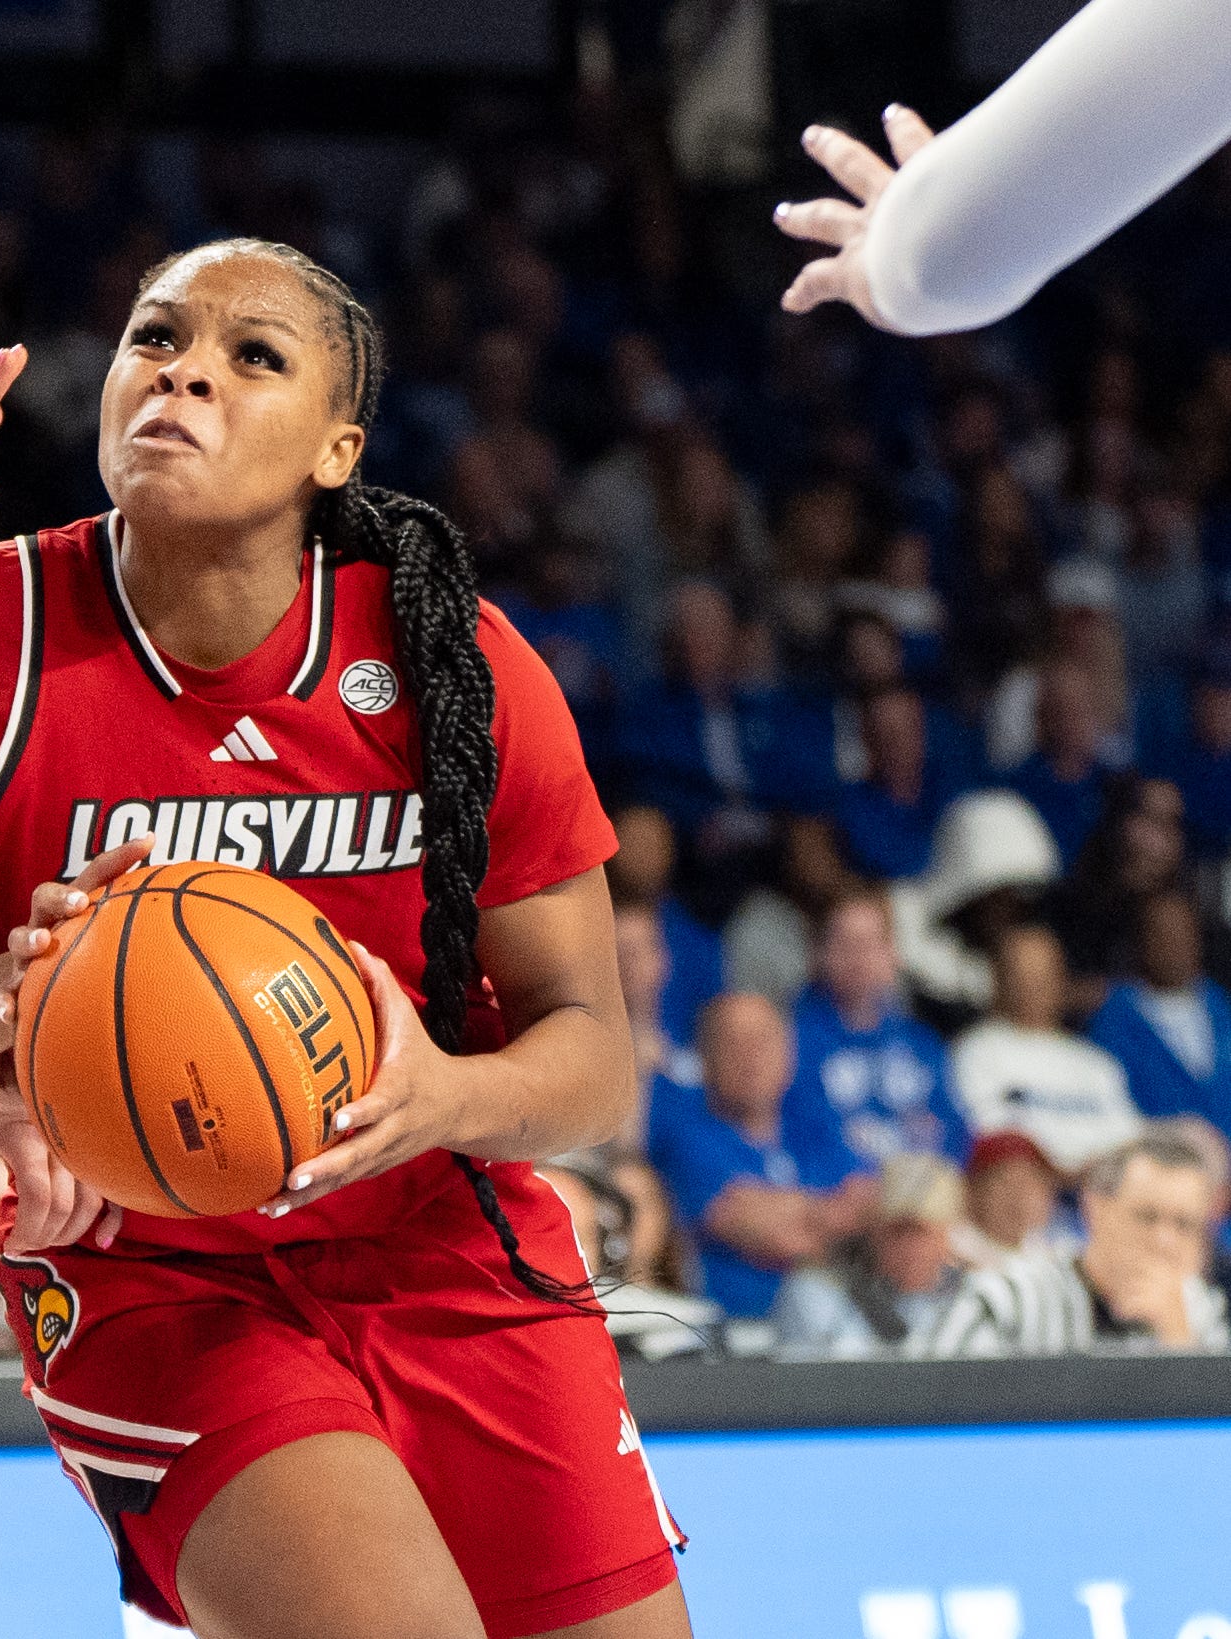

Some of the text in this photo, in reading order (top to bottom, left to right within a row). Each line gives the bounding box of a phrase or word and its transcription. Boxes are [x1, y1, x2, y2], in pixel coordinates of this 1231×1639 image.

[348, 678, 394, 691] ACC
[58, 790, 424, 879] LOUISVILLE
[265, 960, 353, 1145] ELITE
